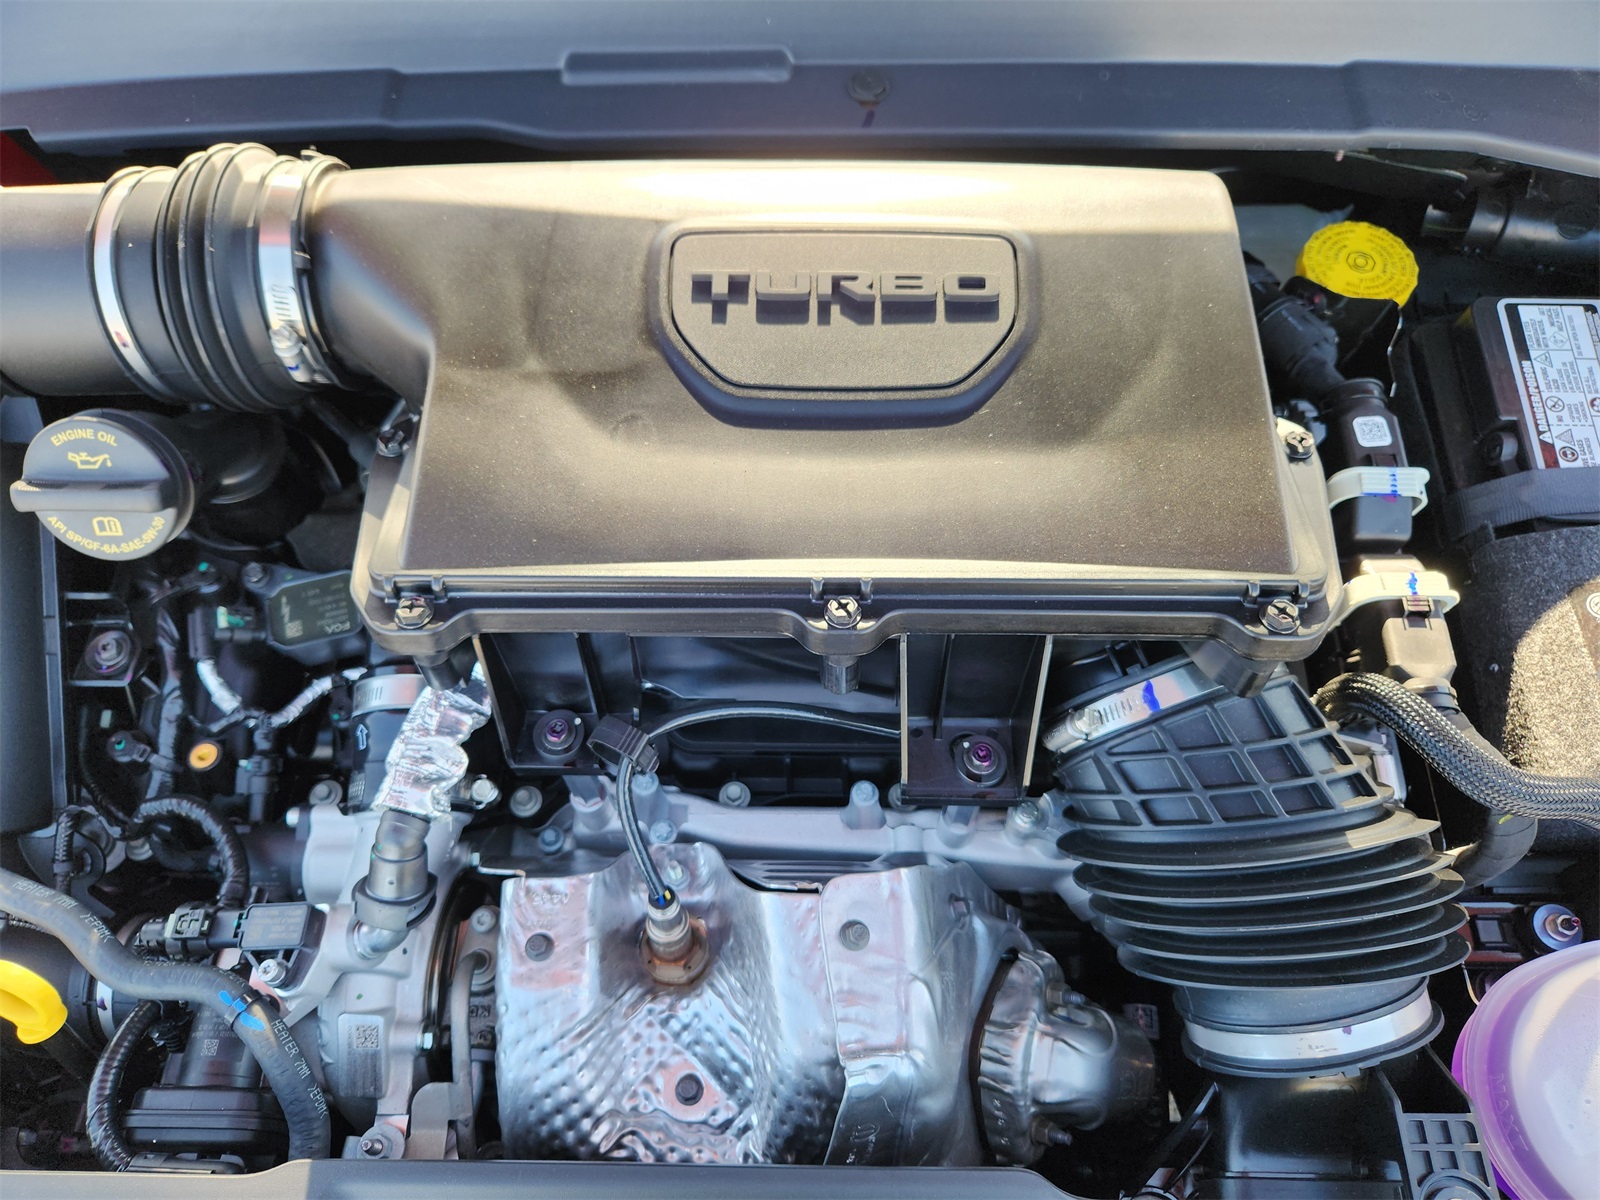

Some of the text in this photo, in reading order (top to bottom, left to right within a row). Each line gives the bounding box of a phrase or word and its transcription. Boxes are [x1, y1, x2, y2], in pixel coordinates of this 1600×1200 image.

[691, 270, 1000, 321] TURBO
[1521, 360, 1549, 432] DANGER/POISON
[51, 429, 118, 447] ENGINE OIL
[1576, 440, 1586, 456] GASES
[47, 516, 67, 534] API
[13, 878, 52, 899] HEATER
[271, 1018, 299, 1058] HEATER
[292, 1058, 311, 1079] 7MM
